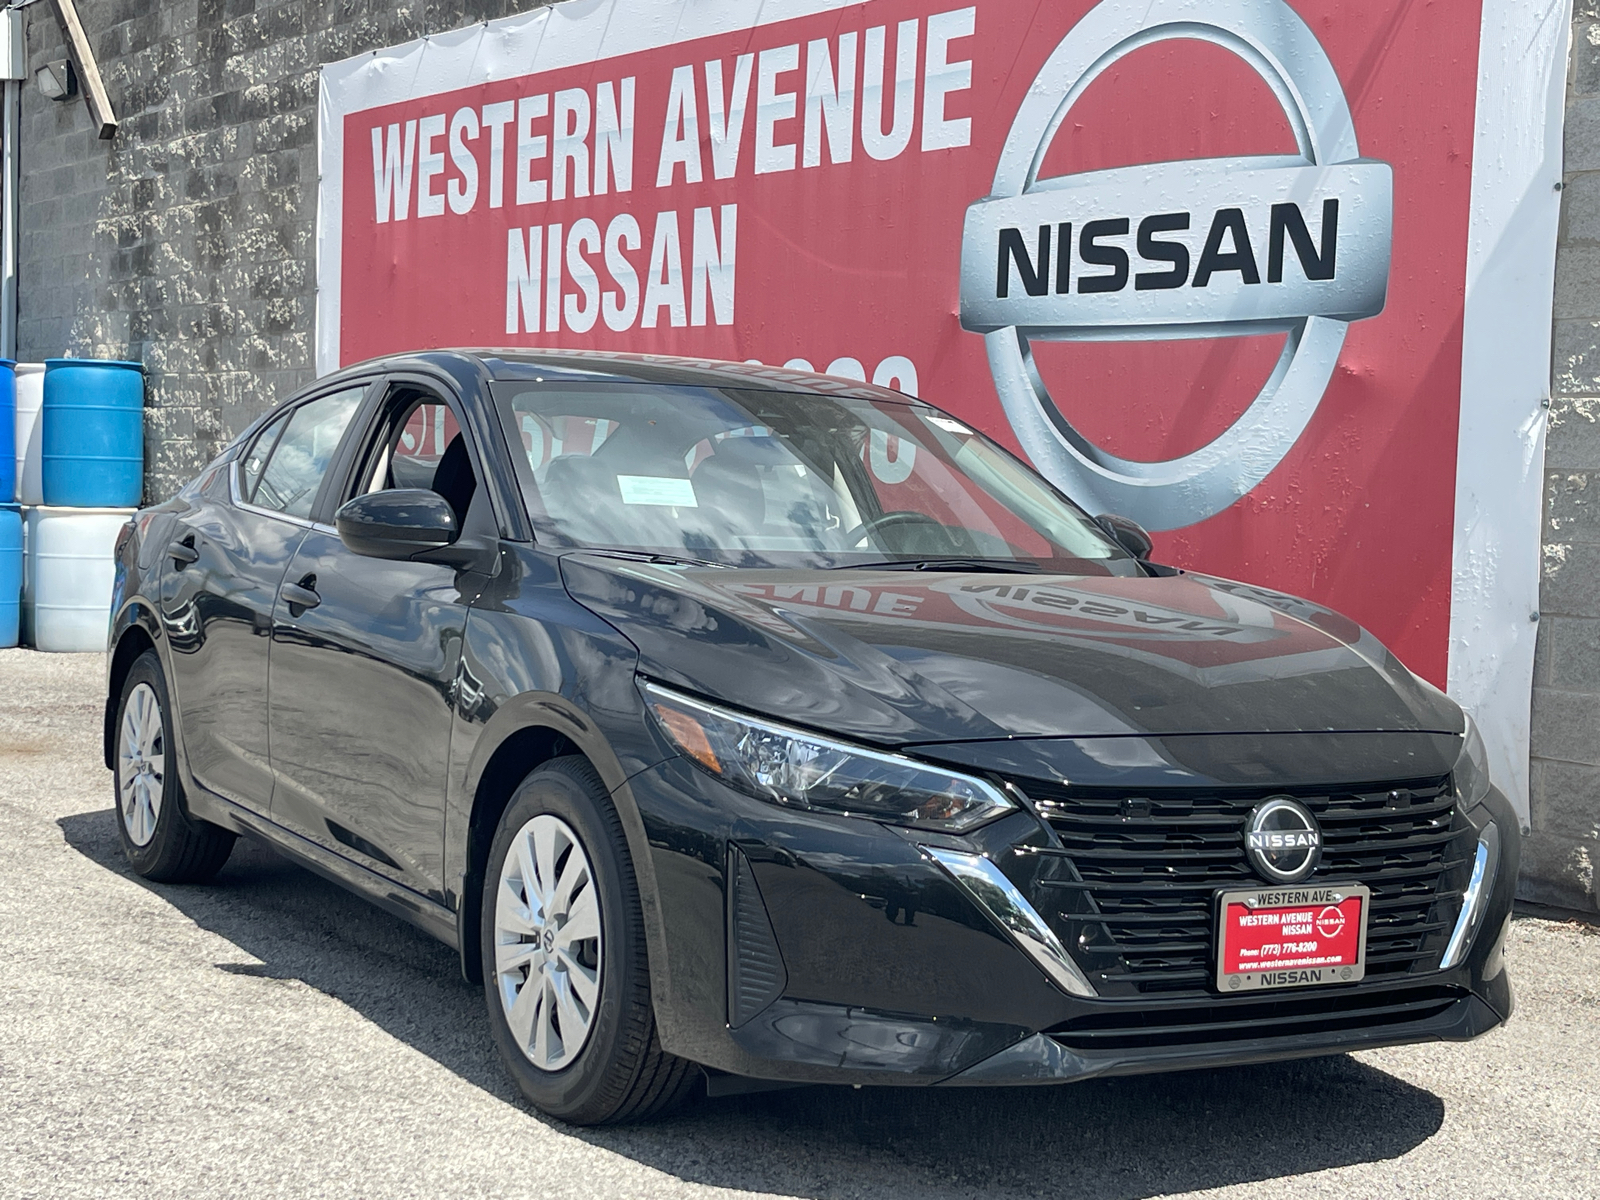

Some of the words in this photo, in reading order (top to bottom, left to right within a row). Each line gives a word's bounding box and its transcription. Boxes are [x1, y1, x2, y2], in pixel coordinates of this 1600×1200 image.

[370, 76, 636, 225] WESTERN
[655, 6, 977, 189] AVENUE
[996, 198, 1340, 299] NISSAN
[505, 203, 738, 335] NISSAN
[1249, 832, 1319, 848] NISSAN
[1257, 891, 1309, 906] WESTERN
[1239, 913, 1279, 927] WESTERN
[1280, 911, 1313, 924] AVENUE
[1315, 917, 1346, 926] NISSAN
[1282, 924, 1313, 936] NISSAN
[1260, 943, 1281, 958] (773)
[1282, 941, 1318, 954] 776-8200
[1238, 955, 1343, 970] www.westernavenissan.com
[1260, 969, 1322, 986] NISSAN
